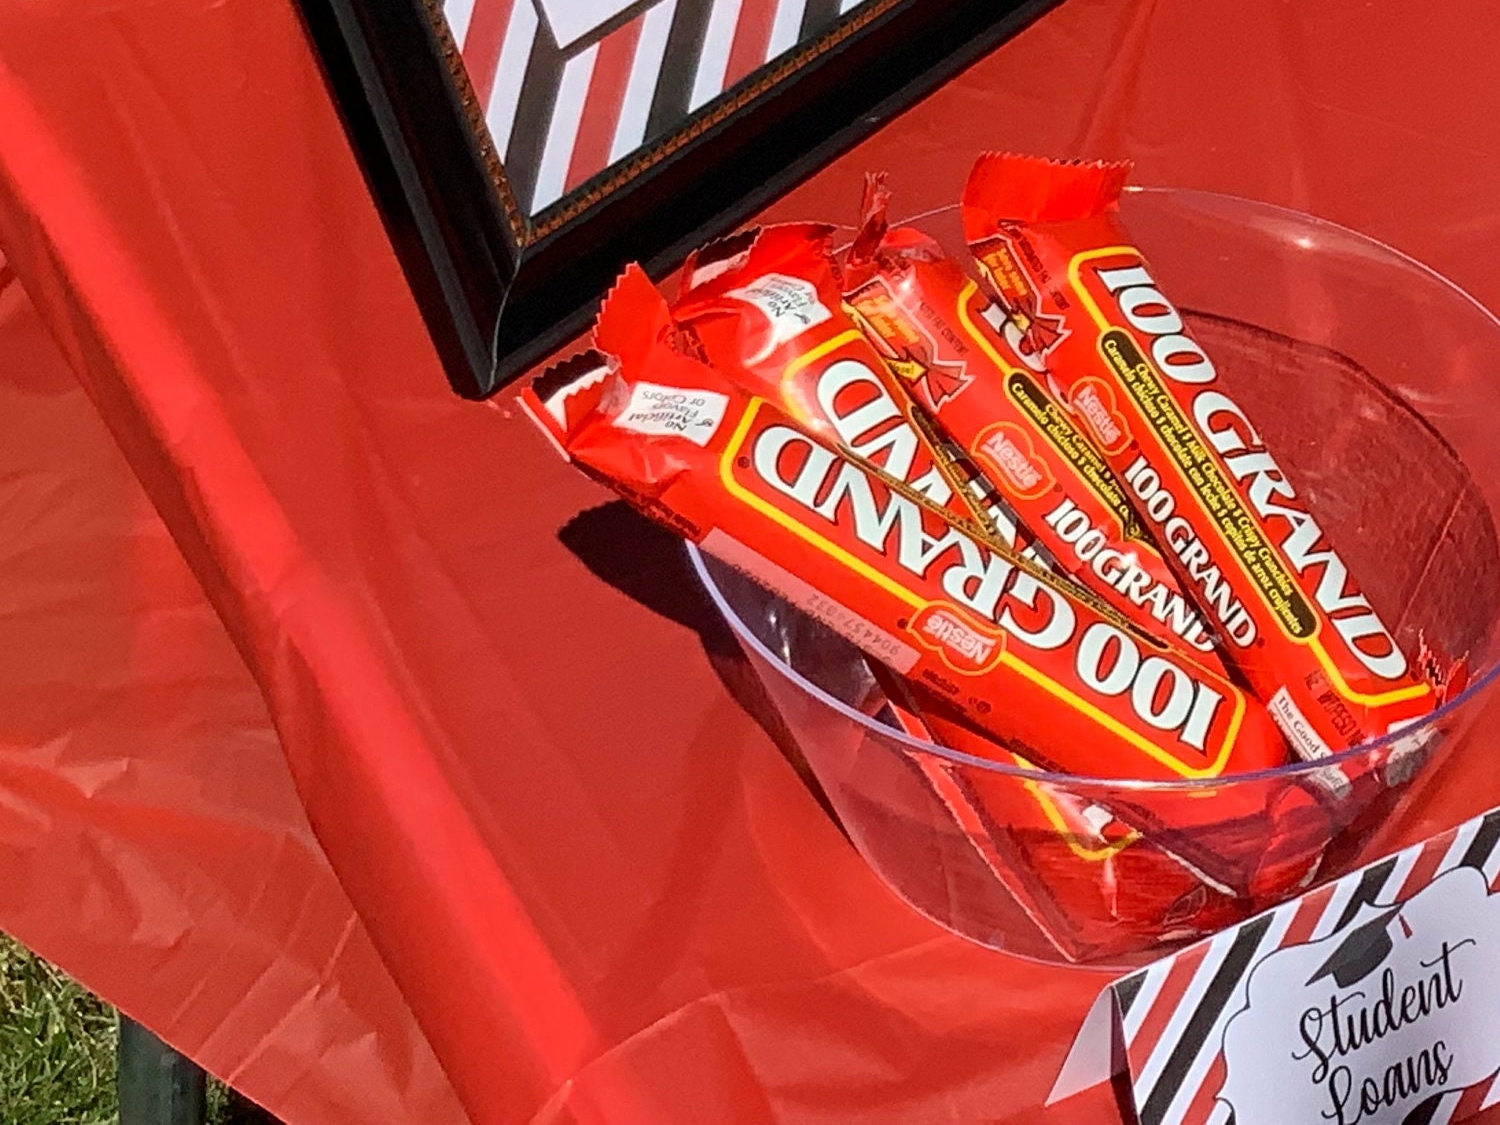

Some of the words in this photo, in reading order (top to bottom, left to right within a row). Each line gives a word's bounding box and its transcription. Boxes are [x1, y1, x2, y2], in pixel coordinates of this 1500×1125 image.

[628, 412, 692, 423] Artificial
[664, 421, 686, 431] No
[1009, 379, 1052, 426] Caramelo
[1044, 420, 1082, 462] chicloso
[1081, 462, 1123, 508] chocolate
[1043, 401, 1075, 437] Chewy
[1069, 432, 1107, 474] Caramel
[1096, 263, 1218, 385] 100
[1192, 390, 1410, 682] GRAND
[1102, 338, 1138, 383] Caramelo
[1129, 378, 1162, 420] chicloso
[1157, 421, 1195, 470] chocolate
[1198, 483, 1223, 512] leche
[1132, 360, 1162, 397] Chewy
[1153, 391, 1189, 436] Caramel
[1199, 460, 1240, 512] Chocolate
[1234, 514, 1264, 550] Crispy
[1255, 545, 1296, 597] Crunchies
[751, 422, 1079, 651] GRAND
[1043, 496, 1110, 572] 100
[1123, 454, 1178, 527] 100
[1168, 515, 1260, 648] GRAND
[1076, 621, 1227, 755] 100
[1274, 695, 1298, 721] The
[1290, 718, 1322, 754] Good
[1292, 938, 1477, 1085] Student
[1321, 1037, 1455, 1125] Loans
